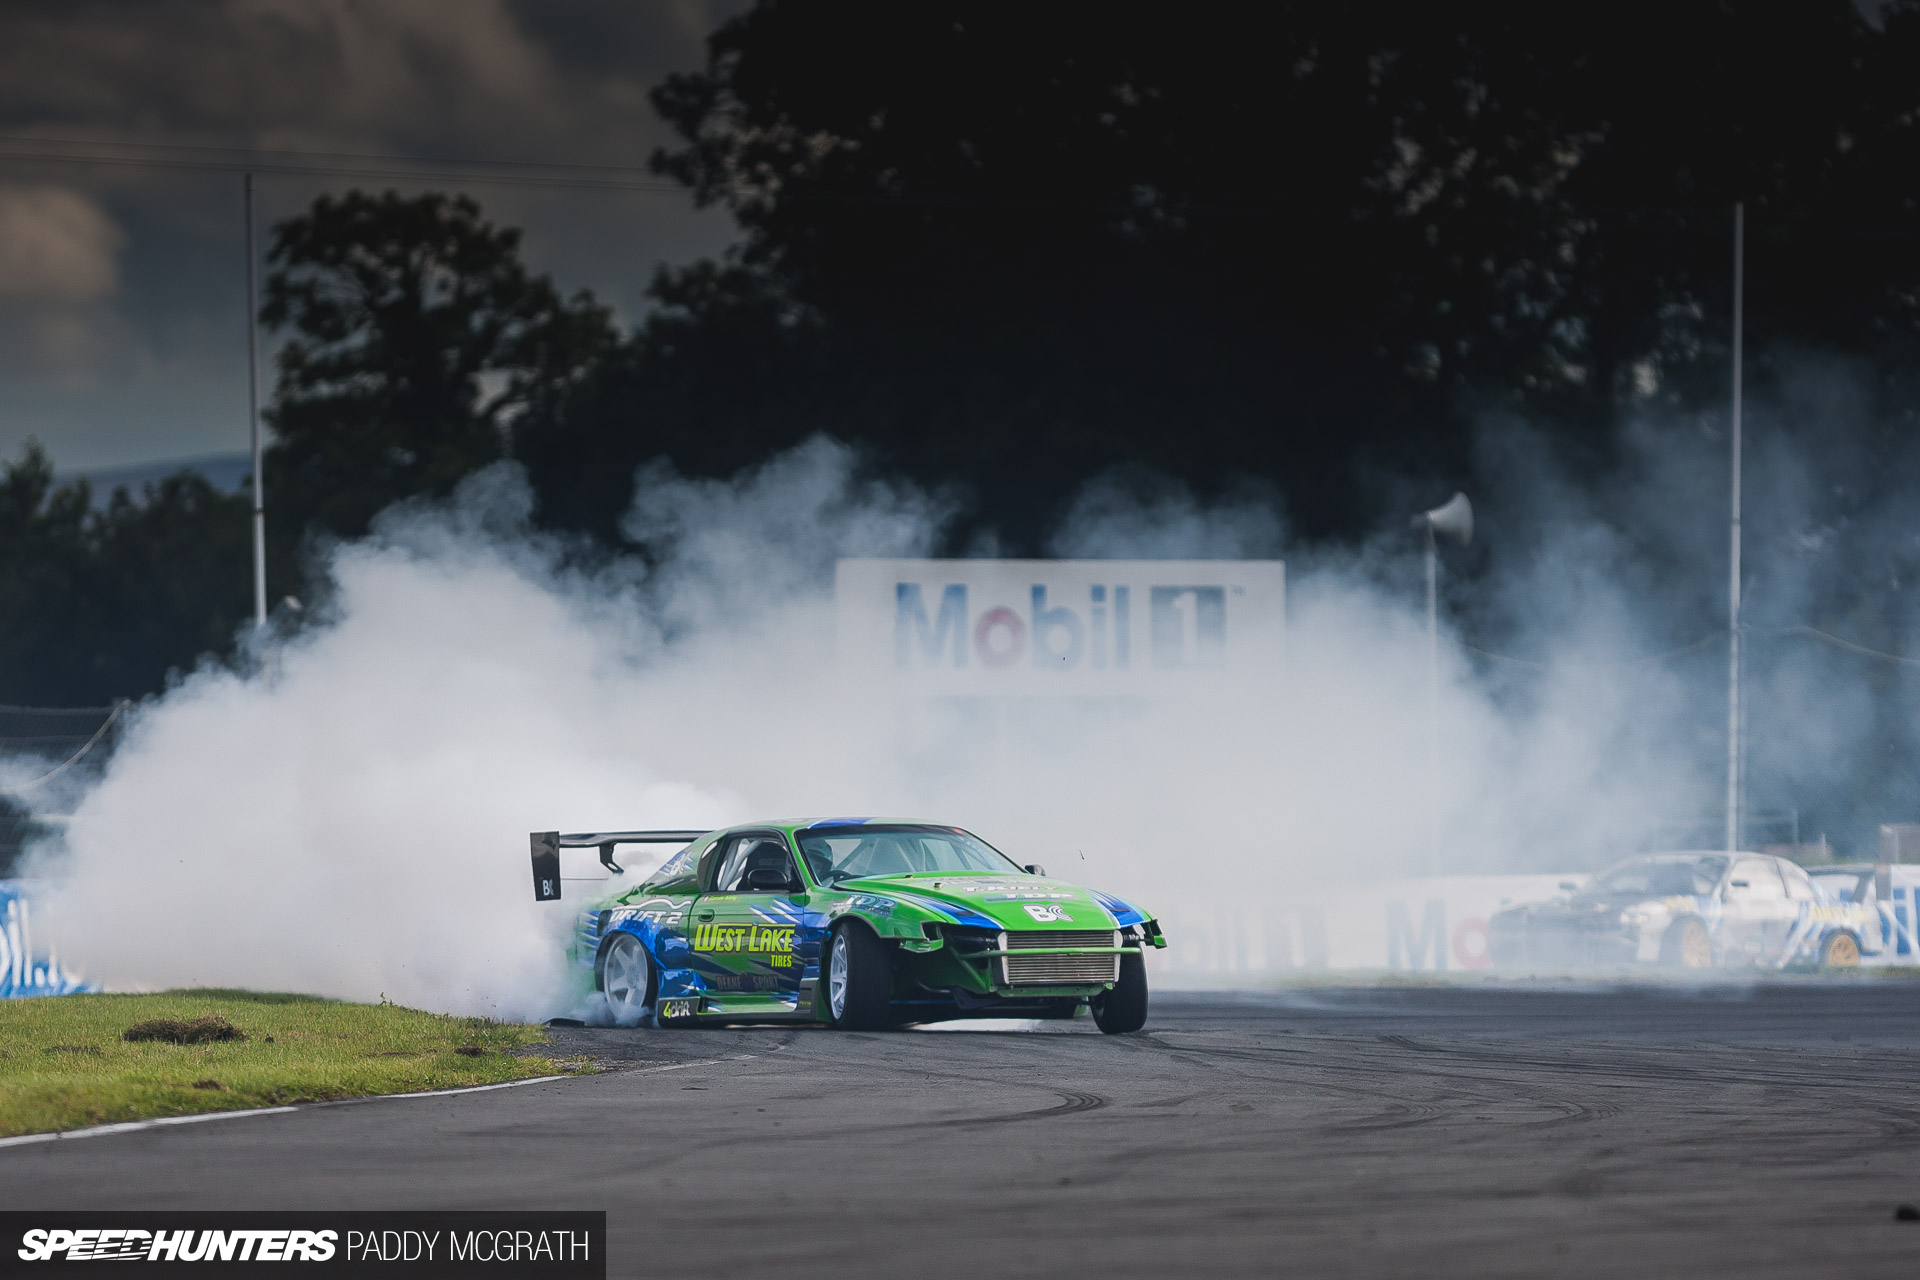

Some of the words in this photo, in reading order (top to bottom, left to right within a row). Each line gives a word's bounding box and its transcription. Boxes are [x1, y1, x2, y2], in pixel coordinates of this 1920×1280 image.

[895, 583, 1131, 670] Mobil
[609, 909, 667, 924] DRIFT
[771, 954, 792, 967] TIRES
